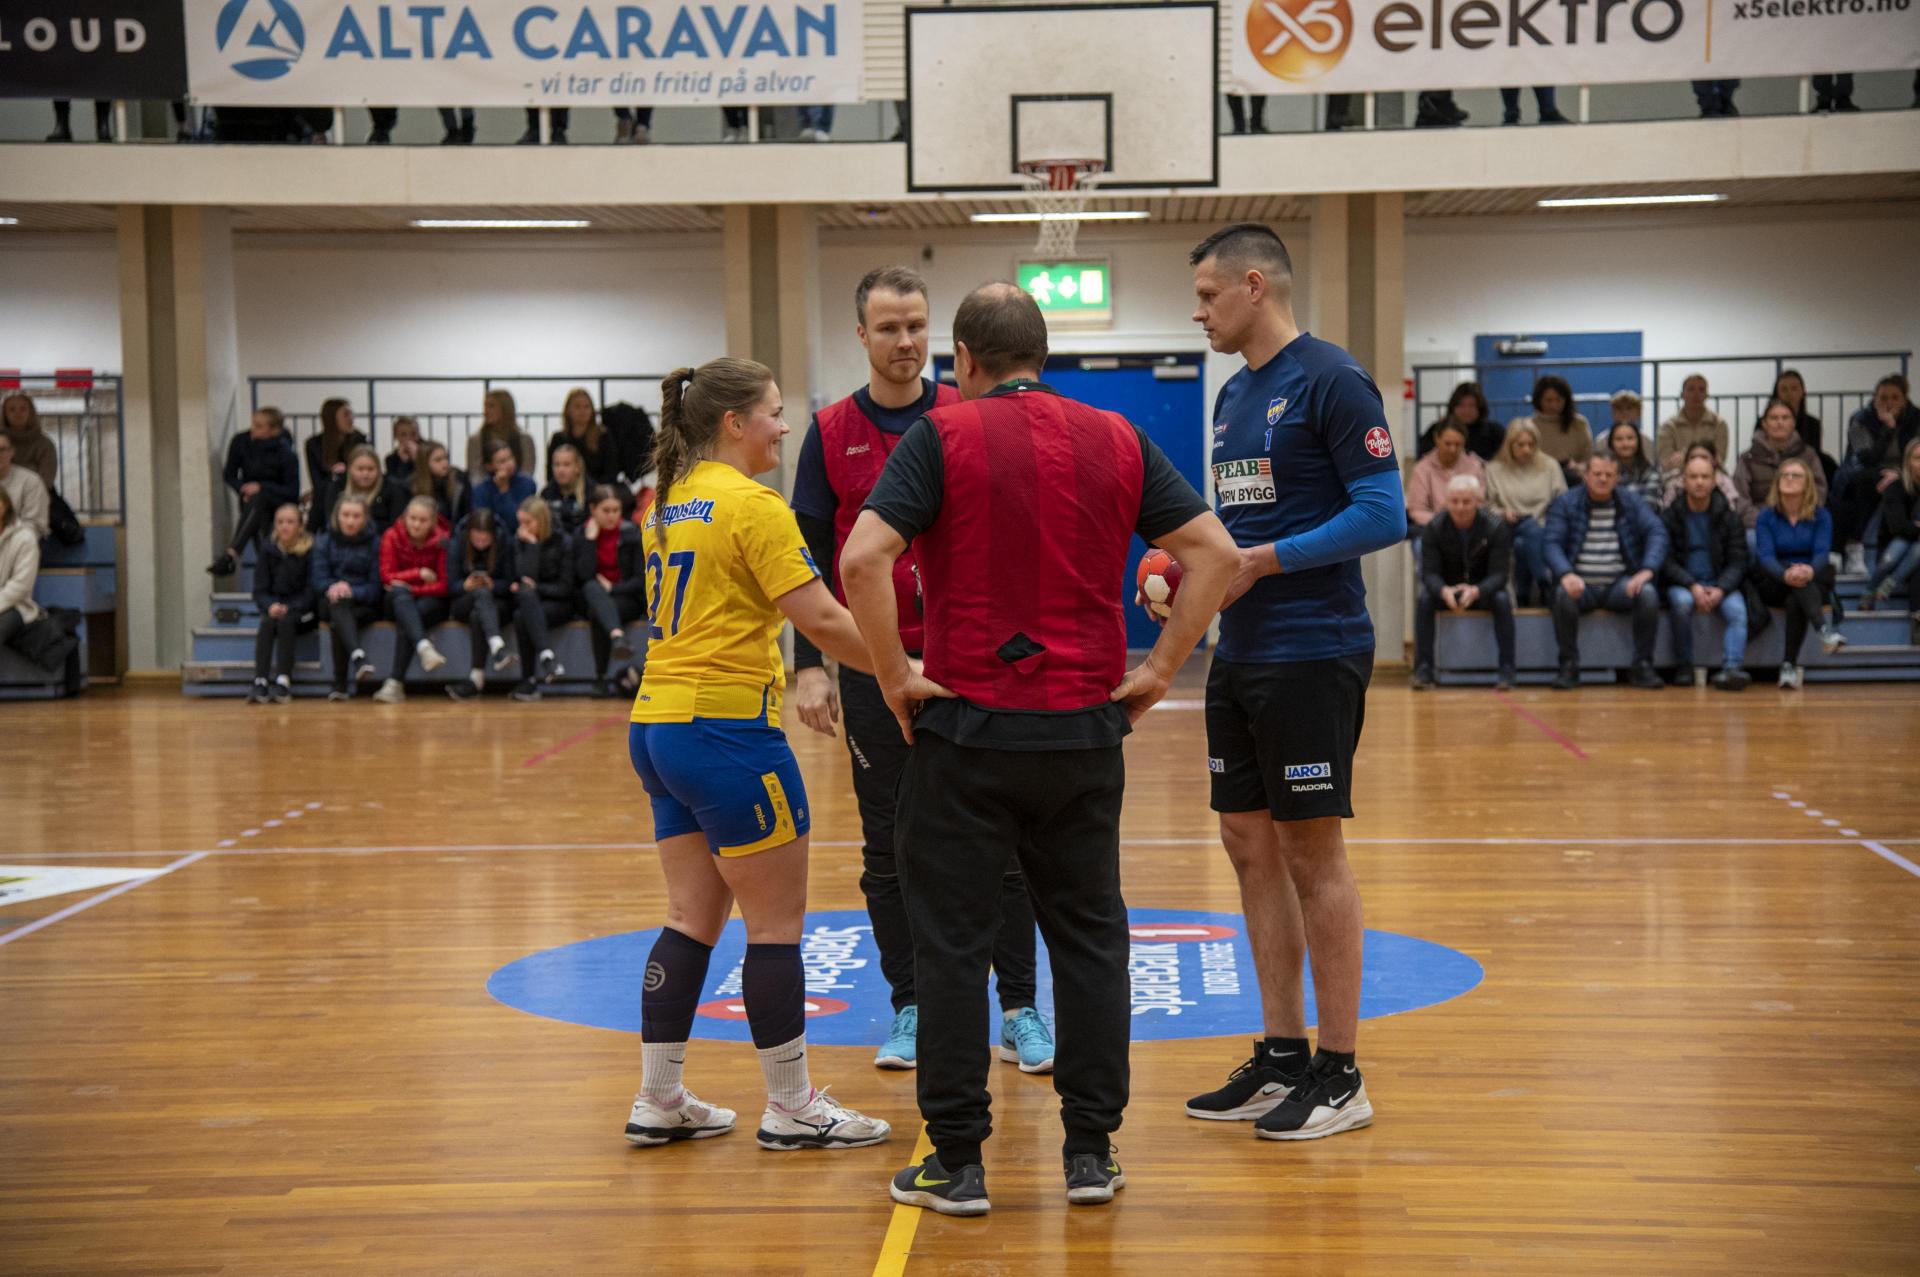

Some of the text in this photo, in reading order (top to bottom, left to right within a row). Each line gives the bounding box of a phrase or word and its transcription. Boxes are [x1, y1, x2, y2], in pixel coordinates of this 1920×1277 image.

[1733, 0, 1911, 20] x5elektro.no
[324, 3, 838, 61] ALTA CARAVAN
[1373, 0, 1684, 52] elektro
[541, 72, 561, 95] vi
[567, 73, 603, 95] tar
[609, 72, 646, 94] din
[653, 71, 713, 94] fritid
[718, 68, 748, 98] på
[754, 70, 816, 92] alvor
[1265, 427, 1273, 452] 1
[1215, 459, 1260, 480] PEAB
[1238, 486, 1275, 502] BYGG
[646, 550, 695, 640] 27
[1287, 764, 1323, 779] JARO
[1291, 783, 1333, 791] DIADORA
[753, 803, 767, 831] umbro
